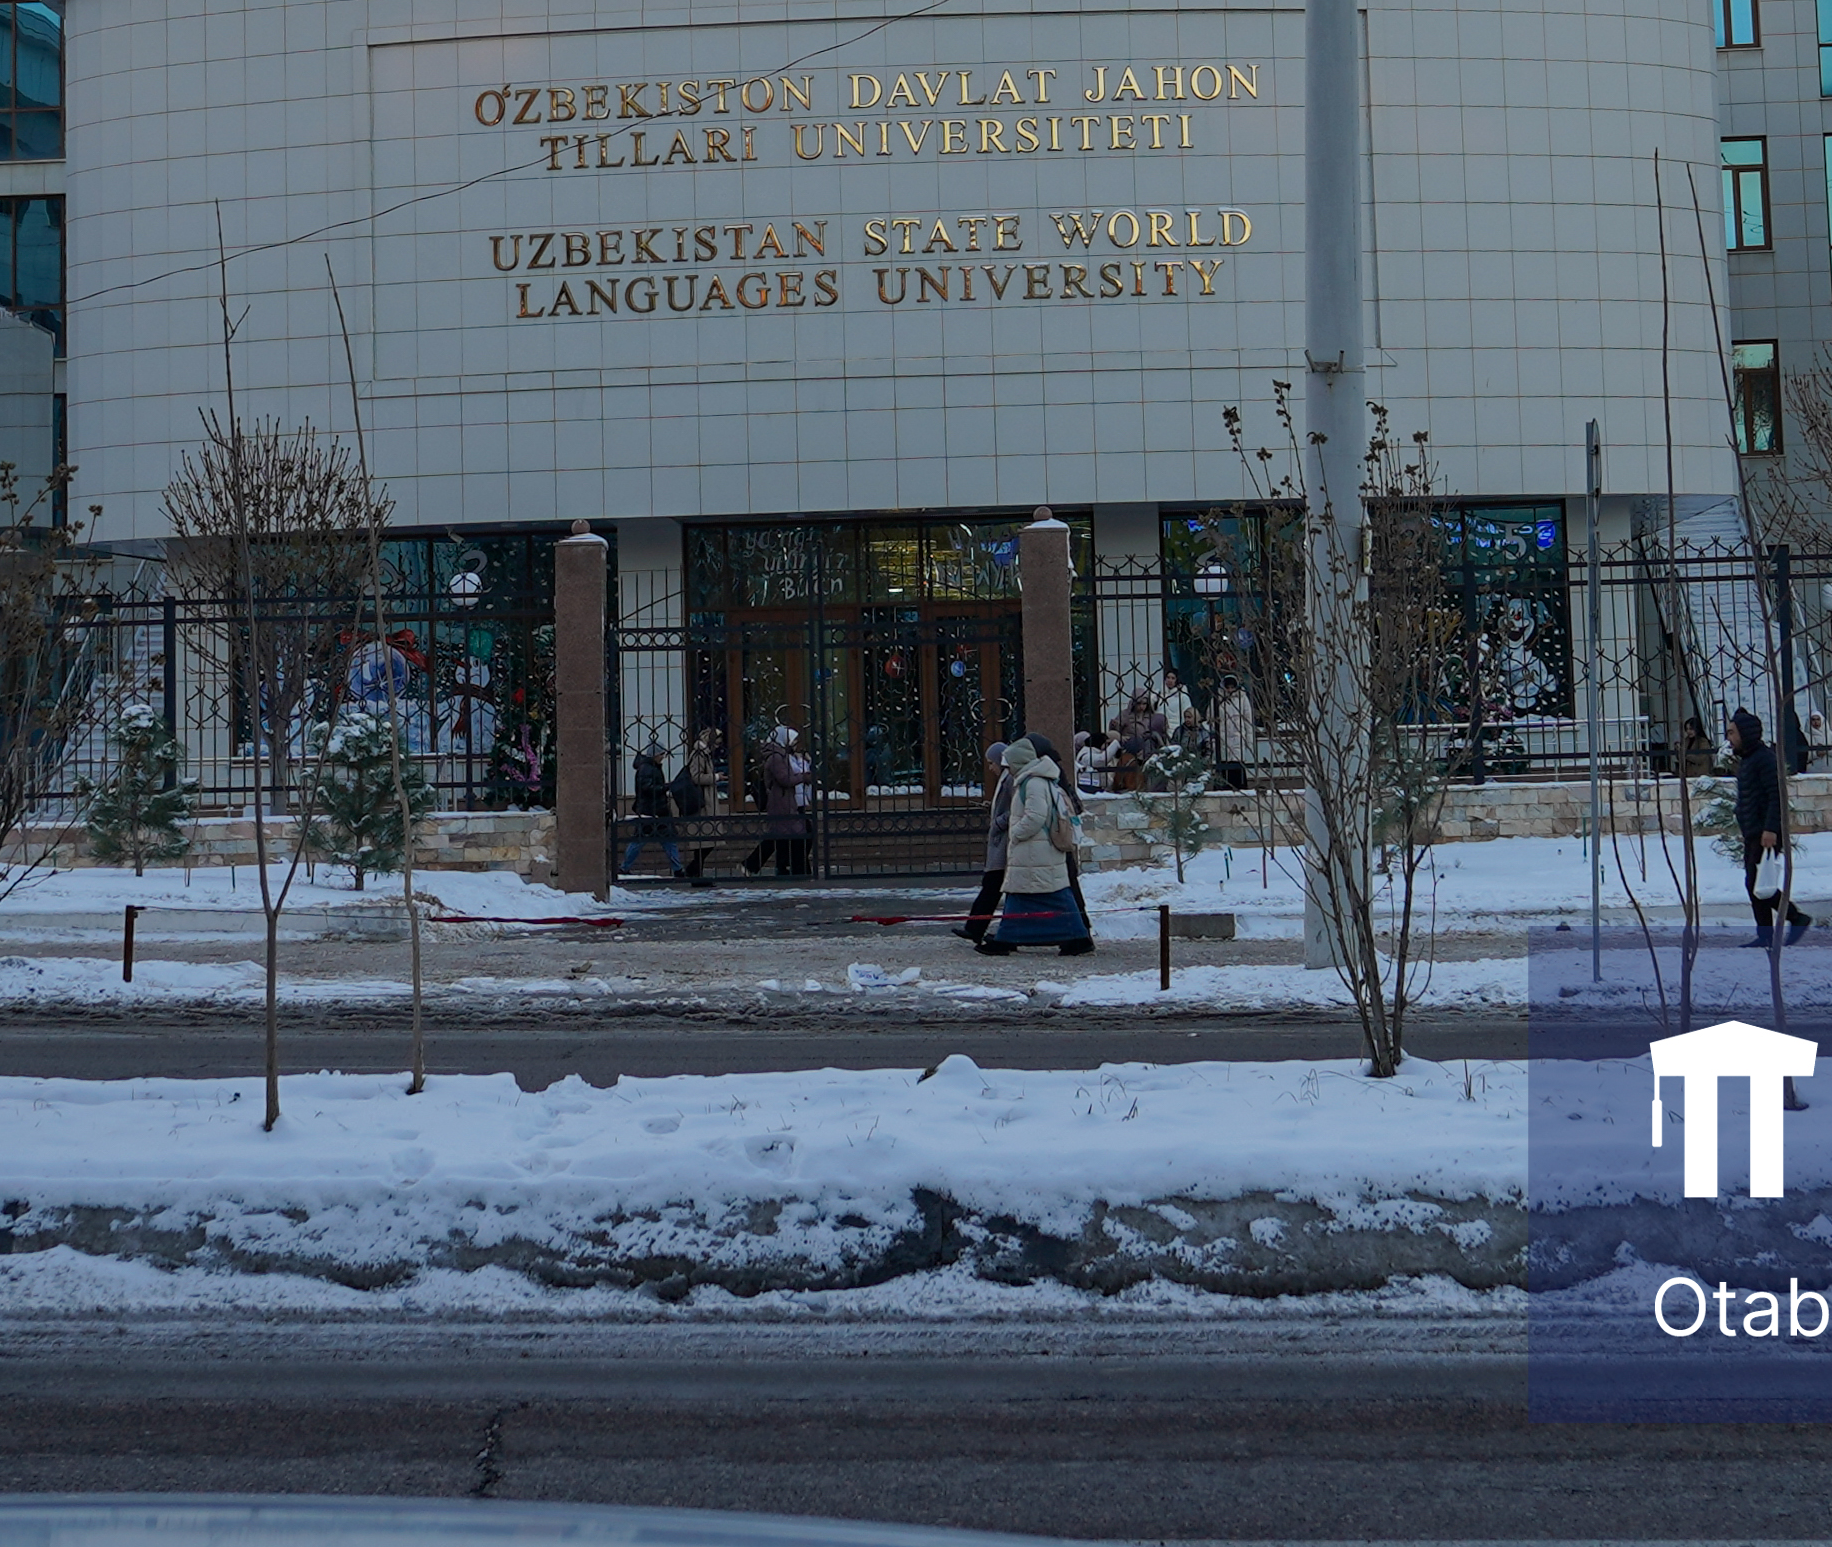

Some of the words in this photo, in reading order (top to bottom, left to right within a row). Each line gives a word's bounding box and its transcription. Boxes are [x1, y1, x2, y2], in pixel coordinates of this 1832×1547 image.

[474, 75, 814, 127] O‘ZBEKISTON
[847, 68, 1057, 110] DAVLAT
[1084, 63, 1260, 103] JAHON
[540, 125, 759, 171] TILLARI
[790, 114, 1194, 161] UNIVERSITETI
[489, 220, 828, 272] UZBEKISTAN
[864, 213, 1023, 256] STATE
[1048, 206, 1254, 250] WORLD
[515, 269, 840, 319] LANGUAGES
[872, 258, 1225, 305] UNIVERSITY
